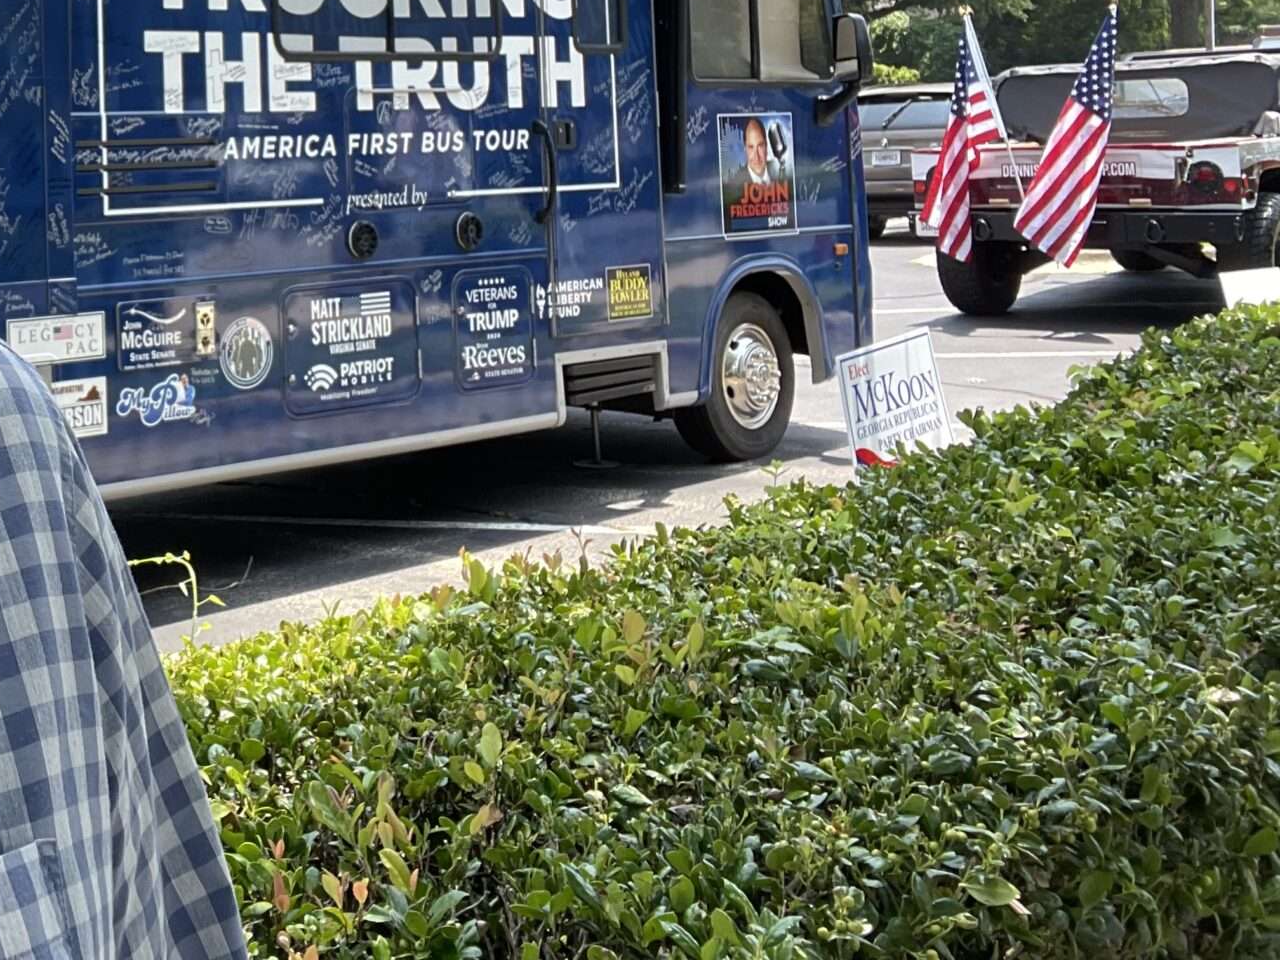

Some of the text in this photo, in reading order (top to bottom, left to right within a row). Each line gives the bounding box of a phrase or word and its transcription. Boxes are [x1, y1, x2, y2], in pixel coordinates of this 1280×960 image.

[143, 30, 317, 115] THE
[339, 35, 586, 113] TRUTH
[223, 134, 336, 160] AMERICA
[348, 132, 413, 156] FIRST
[421, 130, 464, 153] BUS
[473, 128, 529, 151] TOUR
[412, 183, 427, 211] by
[741, 180, 790, 205] JOHN
[730, 201, 790, 218] FREDERICKS
[768, 216, 788, 228] SHOW
[547, 278, 603, 293] AMERICAN
[609, 276, 649, 292] BUDDY
[466, 286, 517, 303] VETERANS
[548, 291, 592, 306] LIBERTY
[610, 288, 650, 305] FOWLER
[311, 298, 340, 320] MATT
[548, 305, 580, 319] FUND
[311, 315, 391, 346] STRICKLAND
[466, 309, 519, 332] TRUMP
[65, 339, 98, 355] PAC
[121, 329, 182, 350] McGUIRE
[340, 357, 394, 377] PATRIOT
[464, 345, 526, 369] Reeves
[340, 372, 392, 387] MOBILE
[848, 363, 870, 380] Elect
[857, 400, 939, 440] GEORGIA REPUBLICAN
[879, 417, 943, 451] PARTY CHAIRMAN
